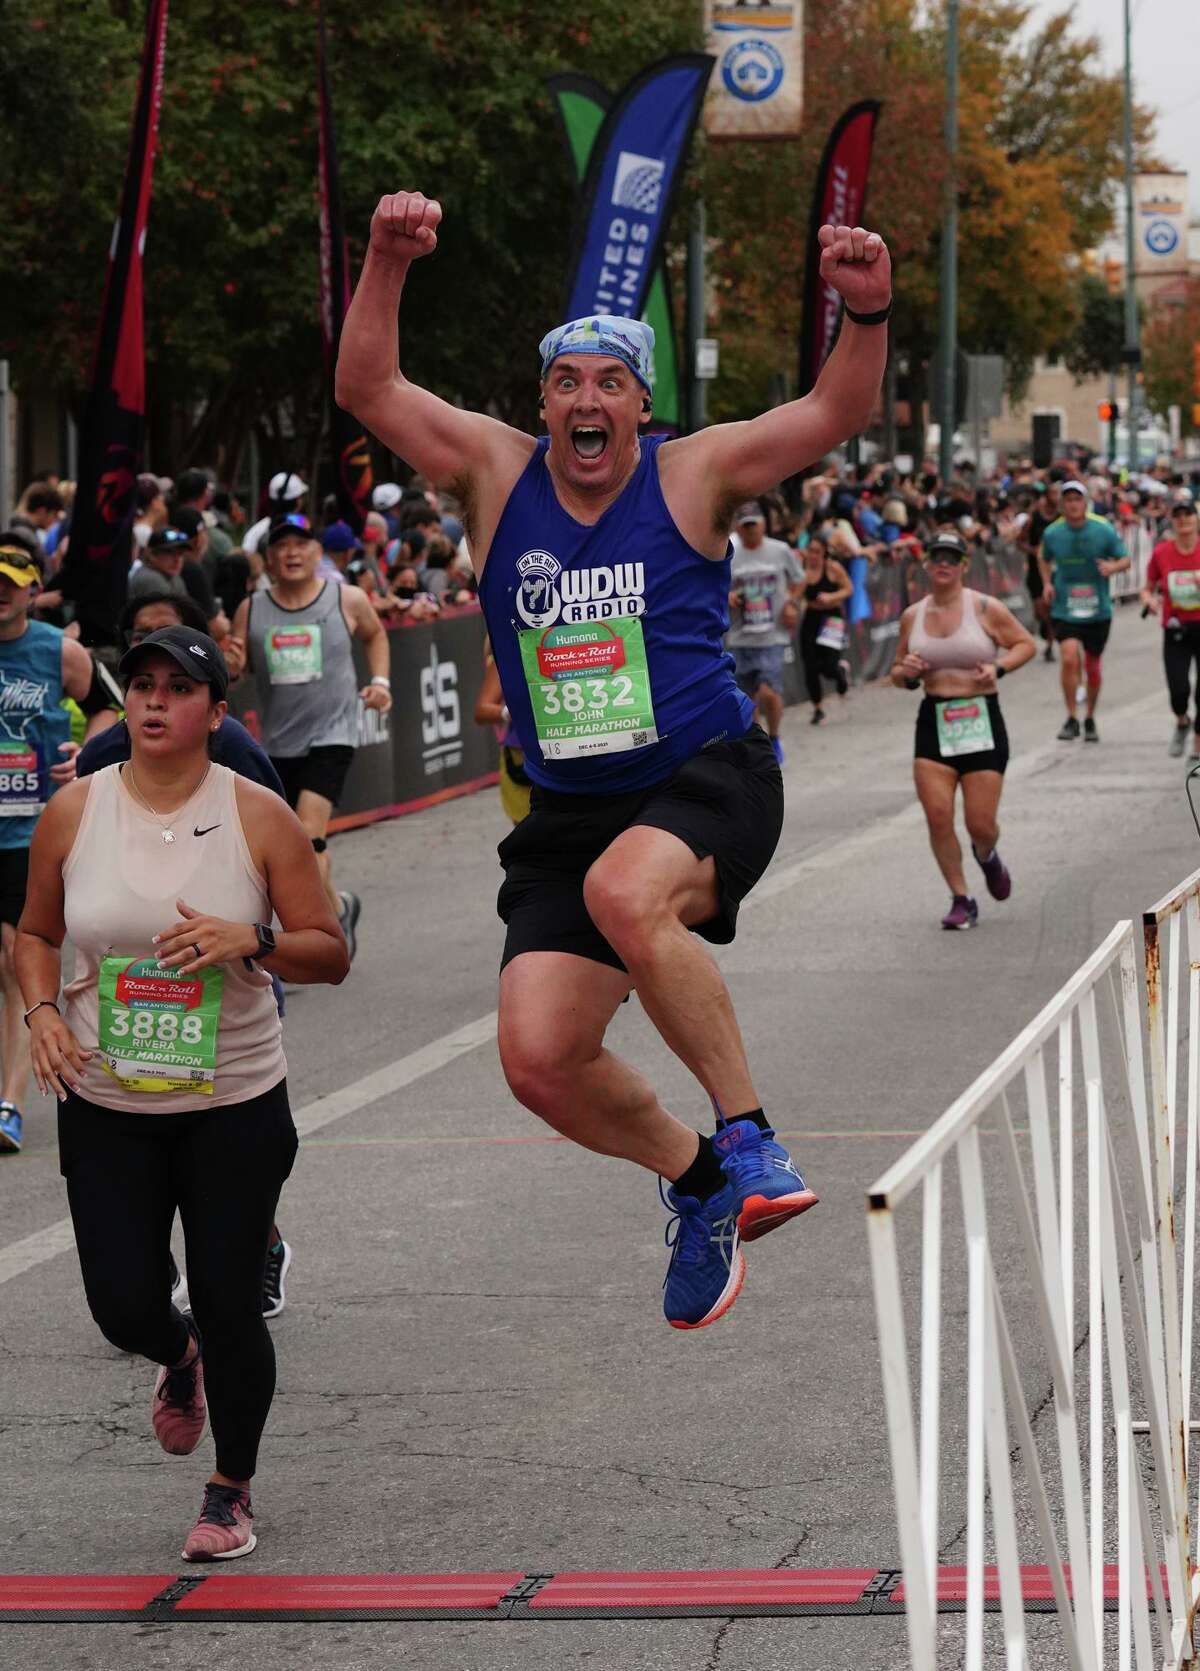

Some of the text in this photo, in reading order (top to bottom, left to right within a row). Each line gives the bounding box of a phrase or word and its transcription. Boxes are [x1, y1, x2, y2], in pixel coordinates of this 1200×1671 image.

[594, 218, 628, 316] ITED
[618, 223, 649, 318] INES
[521, 554, 556, 571] ON THE AIR
[561, 562, 645, 604] WDW
[571, 599, 638, 622] RADIO
[555, 632, 598, 645] Humana
[543, 651, 577, 662] Rock
[588, 645, 617, 656] Roll
[550, 656, 611, 668] RUNNING SERIES
[557, 667, 608, 679] SAN ANTONIO
[540, 675, 635, 715] 3832
[572, 708, 605, 722] JOHN
[546, 717, 641, 737] HALF MARATHON
[141, 967, 181, 979] Humana
[124, 980, 157, 991] Rock
[168, 984, 196, 994] Roll
[149, 1002, 182, 1010] ANTONIO
[109, 1008, 202, 1044] 3888
[132, 1038, 176, 1051] RIVERA
[106, 1045, 202, 1066] HALF MARATHON
